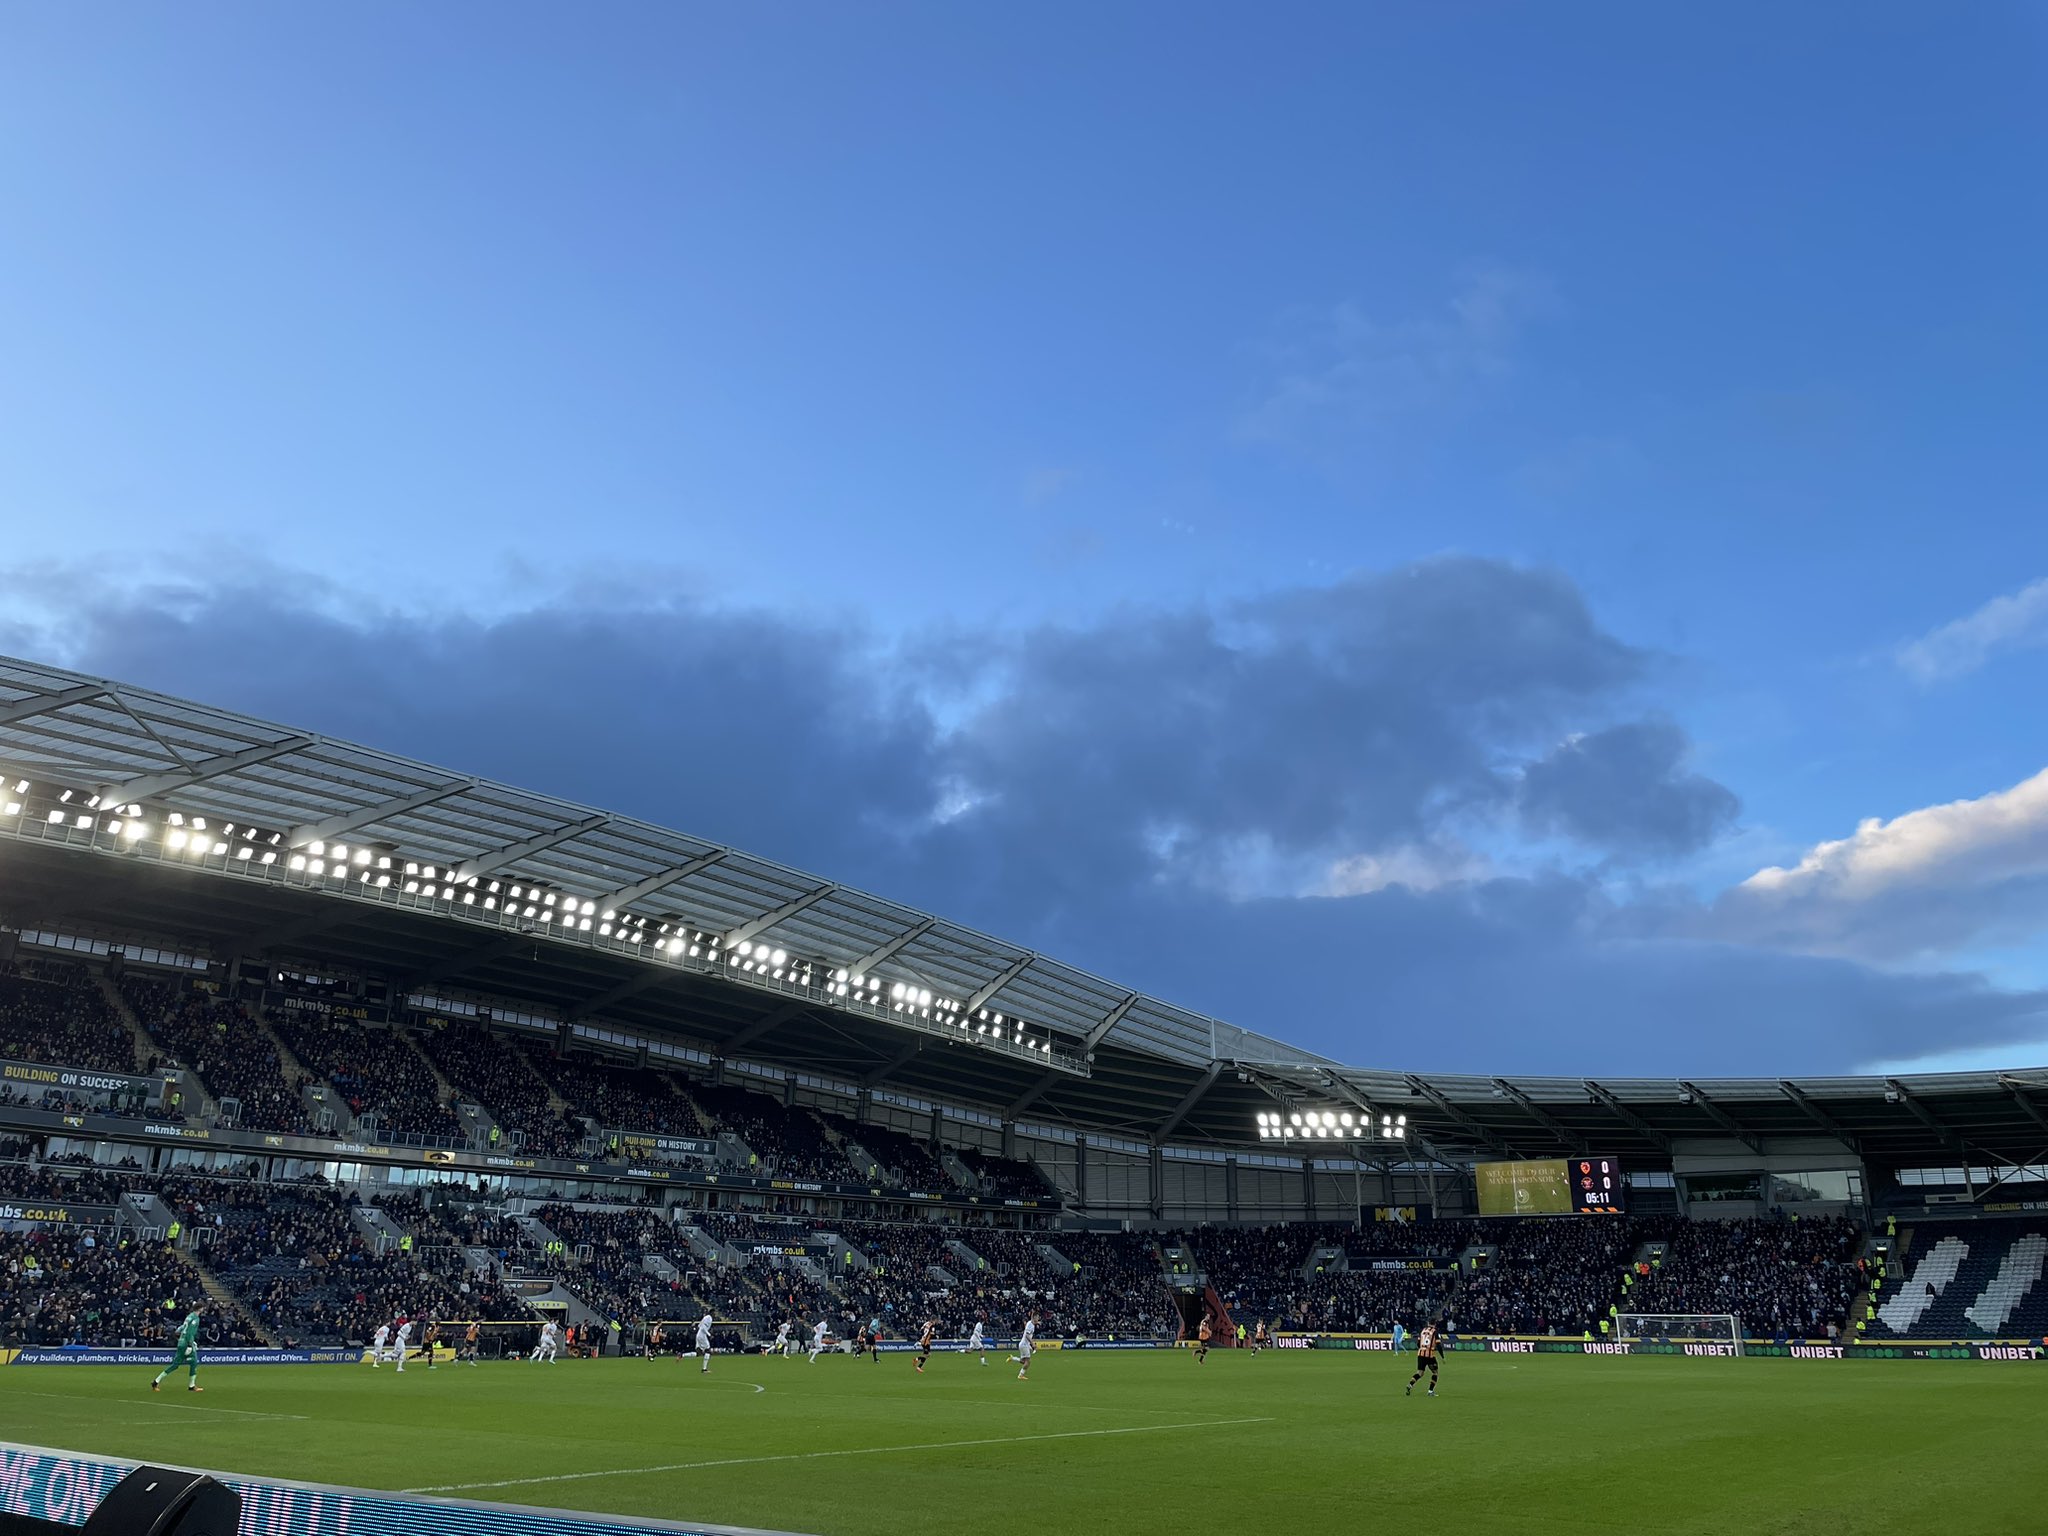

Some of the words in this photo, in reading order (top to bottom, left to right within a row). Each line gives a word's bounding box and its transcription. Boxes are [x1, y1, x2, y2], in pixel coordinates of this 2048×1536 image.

[284, 997, 368, 1019] mkmbs.co.uk
[4, 1066, 58, 1082] BUILDING
[61, 1073, 77, 1085] ON
[144, 1124, 209, 1138] mkmbs.co.uk
[334, 1142, 389, 1155] mkmbs.co.uk
[657, 1139, 667, 1148] ON
[668, 1140, 697, 1151] HISTORY
[487, 1156, 535, 1168] mkmbs.co.uk
[1601, 1160, 1609, 1174] 0
[627, 1168, 670, 1179] mkmbs.co.uk
[1486, 1169, 1524, 1178] WELCOME
[1517, 1176, 1554, 1184] SPONSOR
[1603, 1176, 1611, 1189] 0
[909, 1191, 942, 1200] mkmbs.co.uk
[1585, 1192, 1609, 1203] 05:11
[2023, 1202, 2034, 1210] ON
[1375, 1207, 1416, 1227] MKM
[753, 1245, 806, 1256] mkmbs.co.uk
[1372, 1260, 1434, 1269] mkmbs.co.uk
[1355, 1339, 1393, 1351] UNIBET
[1492, 1342, 1534, 1353] UNIBET
[1584, 1343, 1630, 1354] UNIBET
[1684, 1344, 1734, 1356] UNIBET
[21, 1353, 38, 1363] Hey
[40, 1353, 75, 1363] builders,
[77, 1354, 116, 1363] plumbers,
[118, 1354, 151, 1364] brickies,
[201, 1354, 239, 1362] decorators
[240, 1354, 247, 1362] &
[247, 1354, 281, 1362] weekend
[310, 1353, 335, 1361] BRING
[336, 1353, 344, 1361] IT
[1790, 1346, 1844, 1359] UNIBET
[1979, 1347, 2037, 1360] UNIBET
